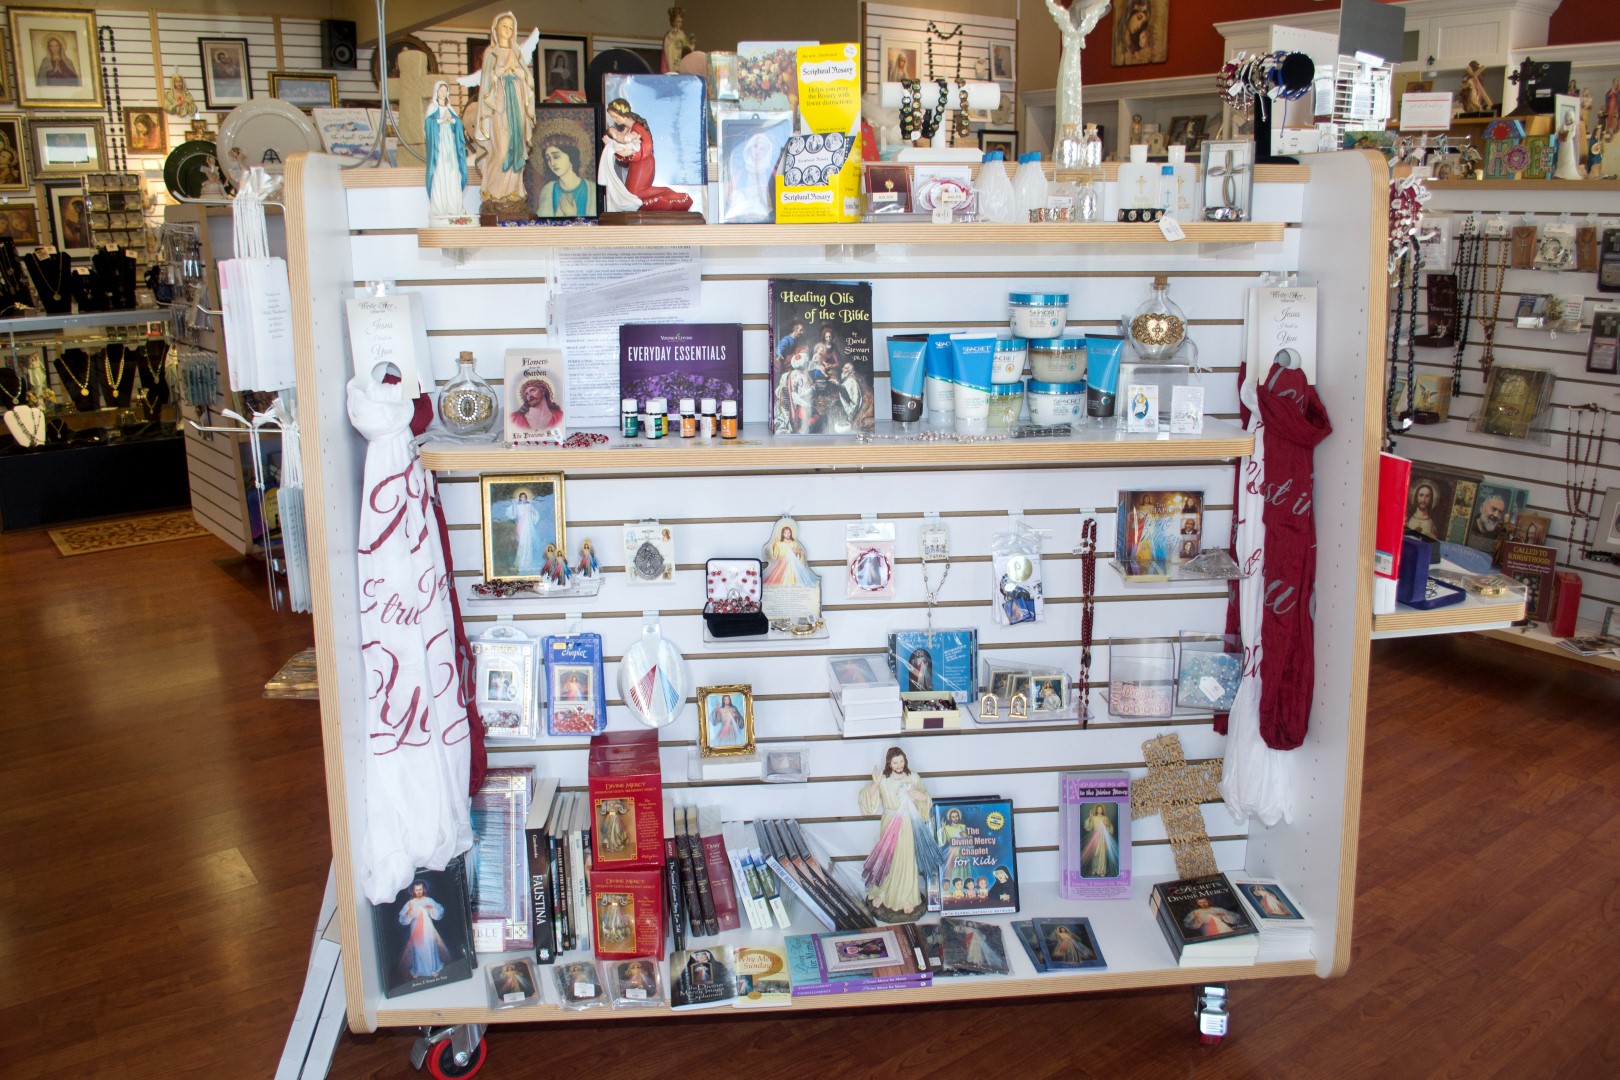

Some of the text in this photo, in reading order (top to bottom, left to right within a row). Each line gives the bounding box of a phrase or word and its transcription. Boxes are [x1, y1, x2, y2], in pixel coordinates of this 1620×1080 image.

[802, 67, 830, 76] Scriptural
[837, 86, 848, 94] pray
[817, 92, 837, 100] Rosary
[784, 194, 809, 202] Scriptural
[780, 291, 854, 307] Healing Oils
[804, 308, 870, 324] of the Bible
[1274, 307, 1300, 322] Jesus
[366, 319, 393, 335] Jesus
[1277, 331, 1296, 346] You
[628, 346, 726, 361] EVERYDAY ESSENTIALS
[845, 346, 869, 354] Stewart
[522, 357, 548, 366] Flowers
[1513, 546, 1537, 555] CALLED
[967, 827, 980, 835] The
[952, 837, 996, 846] Divine Mercy
[961, 848, 989, 856] Chaplet
[954, 855, 997, 868] for Kids
[1168, 882, 1221, 896] 7 SECRETS
[532, 874, 548, 925] FAUSTINA
[1166, 888, 1229, 903] DIVINE MERCY
[473, 928, 498, 938] IBLE
